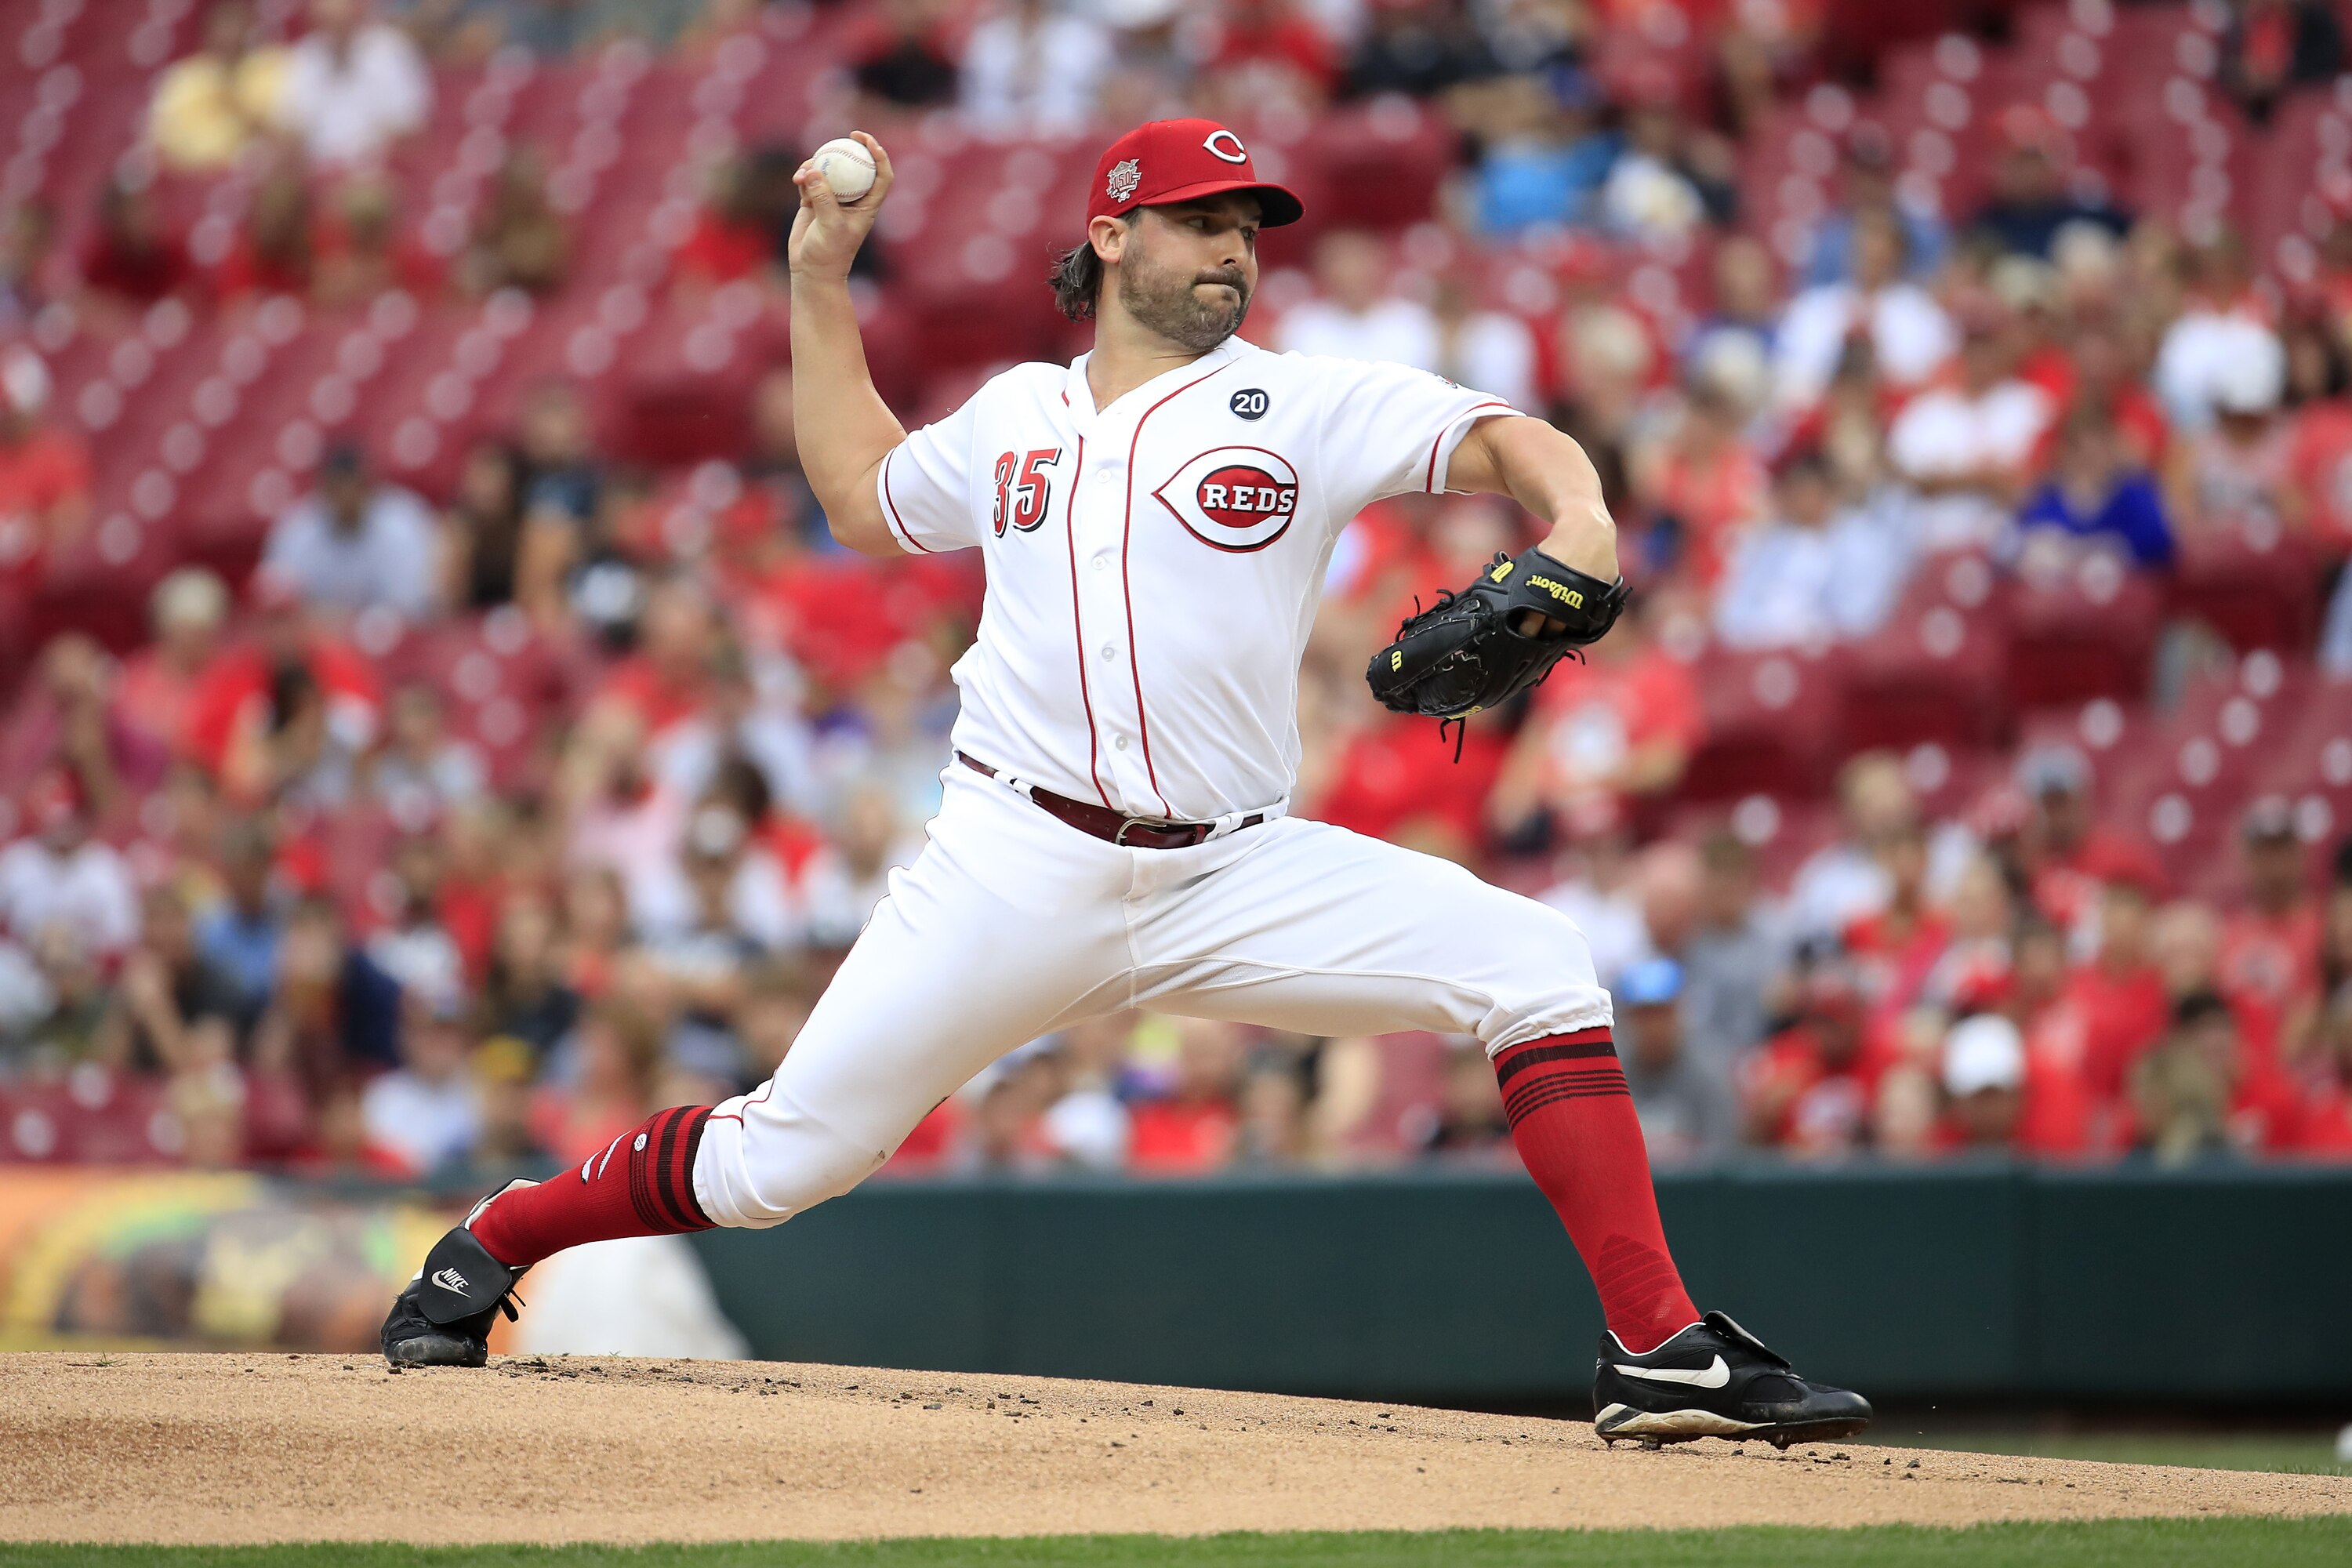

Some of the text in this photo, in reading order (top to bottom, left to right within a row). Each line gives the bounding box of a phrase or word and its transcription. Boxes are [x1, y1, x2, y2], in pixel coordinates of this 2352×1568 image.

[1202, 129, 1247, 165] C
[1234, 393, 1265, 413] 20
[993, 448, 1063, 539] 35
[1202, 483, 1297, 514] REDS
[1531, 575, 1584, 610] Wilson
[441, 1267, 470, 1290] NIKE
